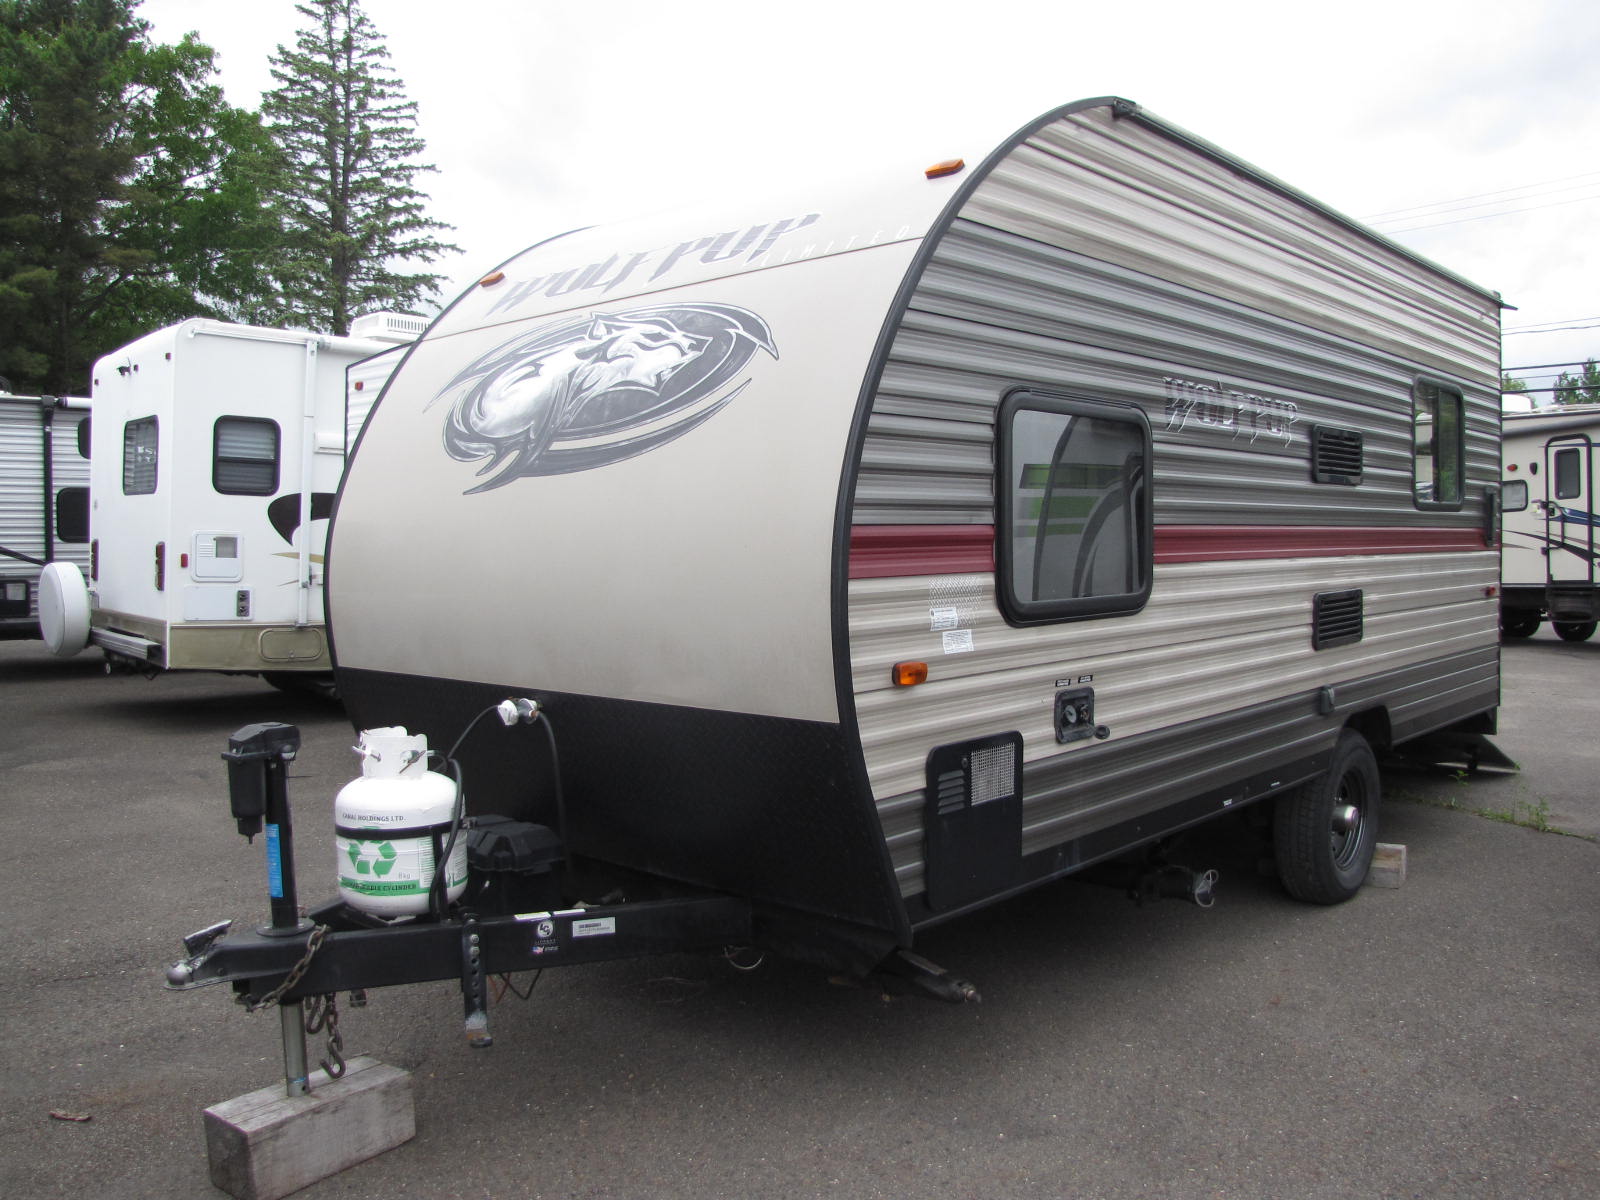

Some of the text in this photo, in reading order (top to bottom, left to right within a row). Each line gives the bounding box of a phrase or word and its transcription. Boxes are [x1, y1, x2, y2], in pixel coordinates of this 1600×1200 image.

[485, 212, 822, 319] WOLF PUP
[1161, 376, 1299, 449] WOLF PUP
